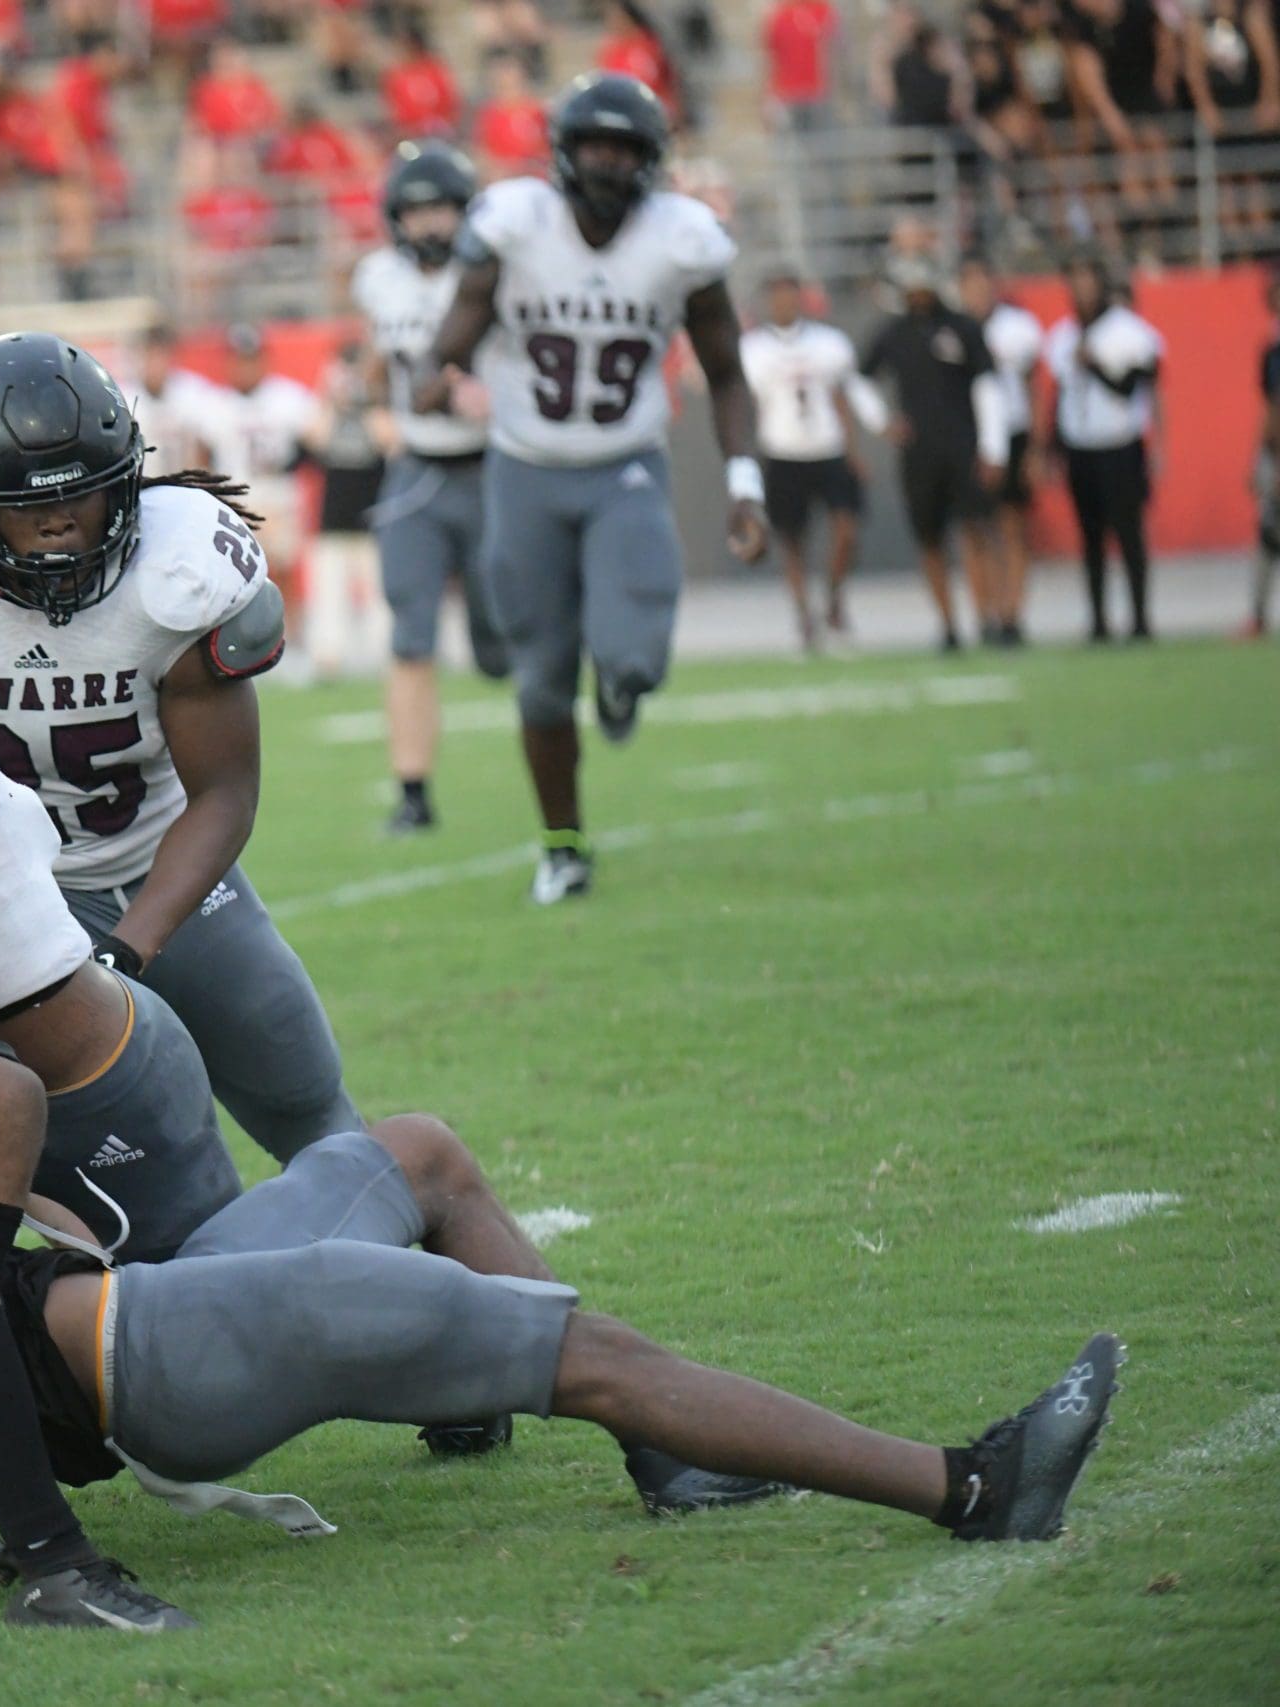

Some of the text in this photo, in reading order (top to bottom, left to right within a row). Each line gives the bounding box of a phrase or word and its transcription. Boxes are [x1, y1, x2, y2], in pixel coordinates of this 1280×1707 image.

[526, 333, 652, 425] 99
[31, 467, 83, 487] Riddell
[213, 508, 260, 584] 25
[14, 658, 59, 669] adidas
[200, 889, 238, 917] adidas
[89, 1147, 145, 1169] adidas
